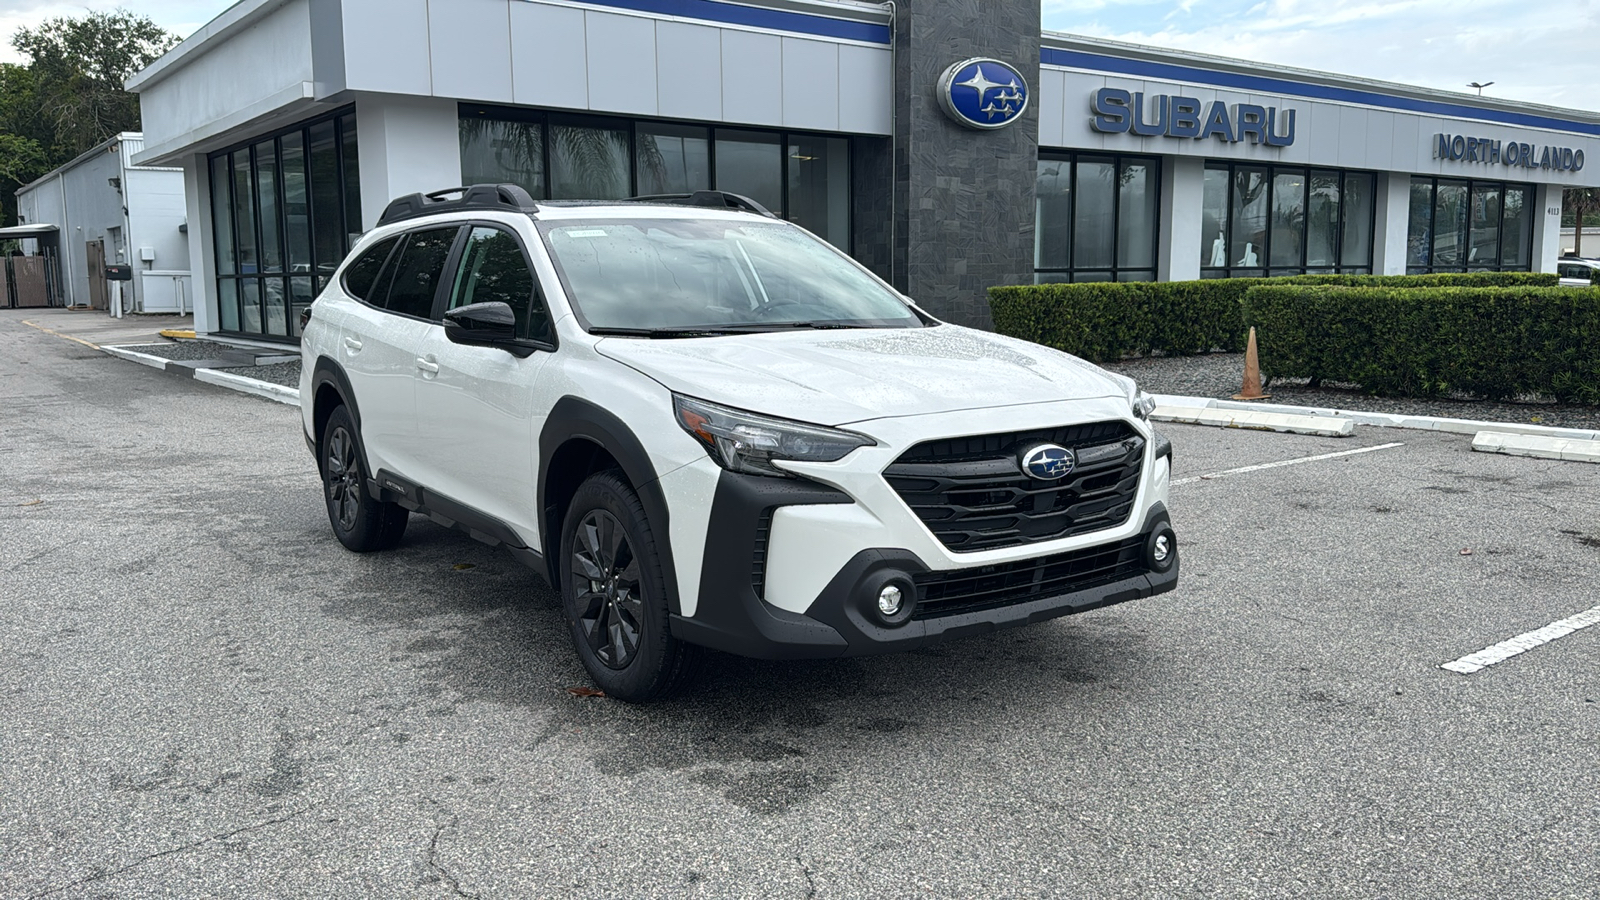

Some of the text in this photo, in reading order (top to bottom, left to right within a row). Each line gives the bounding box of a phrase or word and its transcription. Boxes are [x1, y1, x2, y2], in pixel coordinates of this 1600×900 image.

[1090, 87, 1296, 147] SUBARU
[1433, 133, 1585, 171] NORTH ORLANDO
[1547, 207, 1560, 216] 4113
